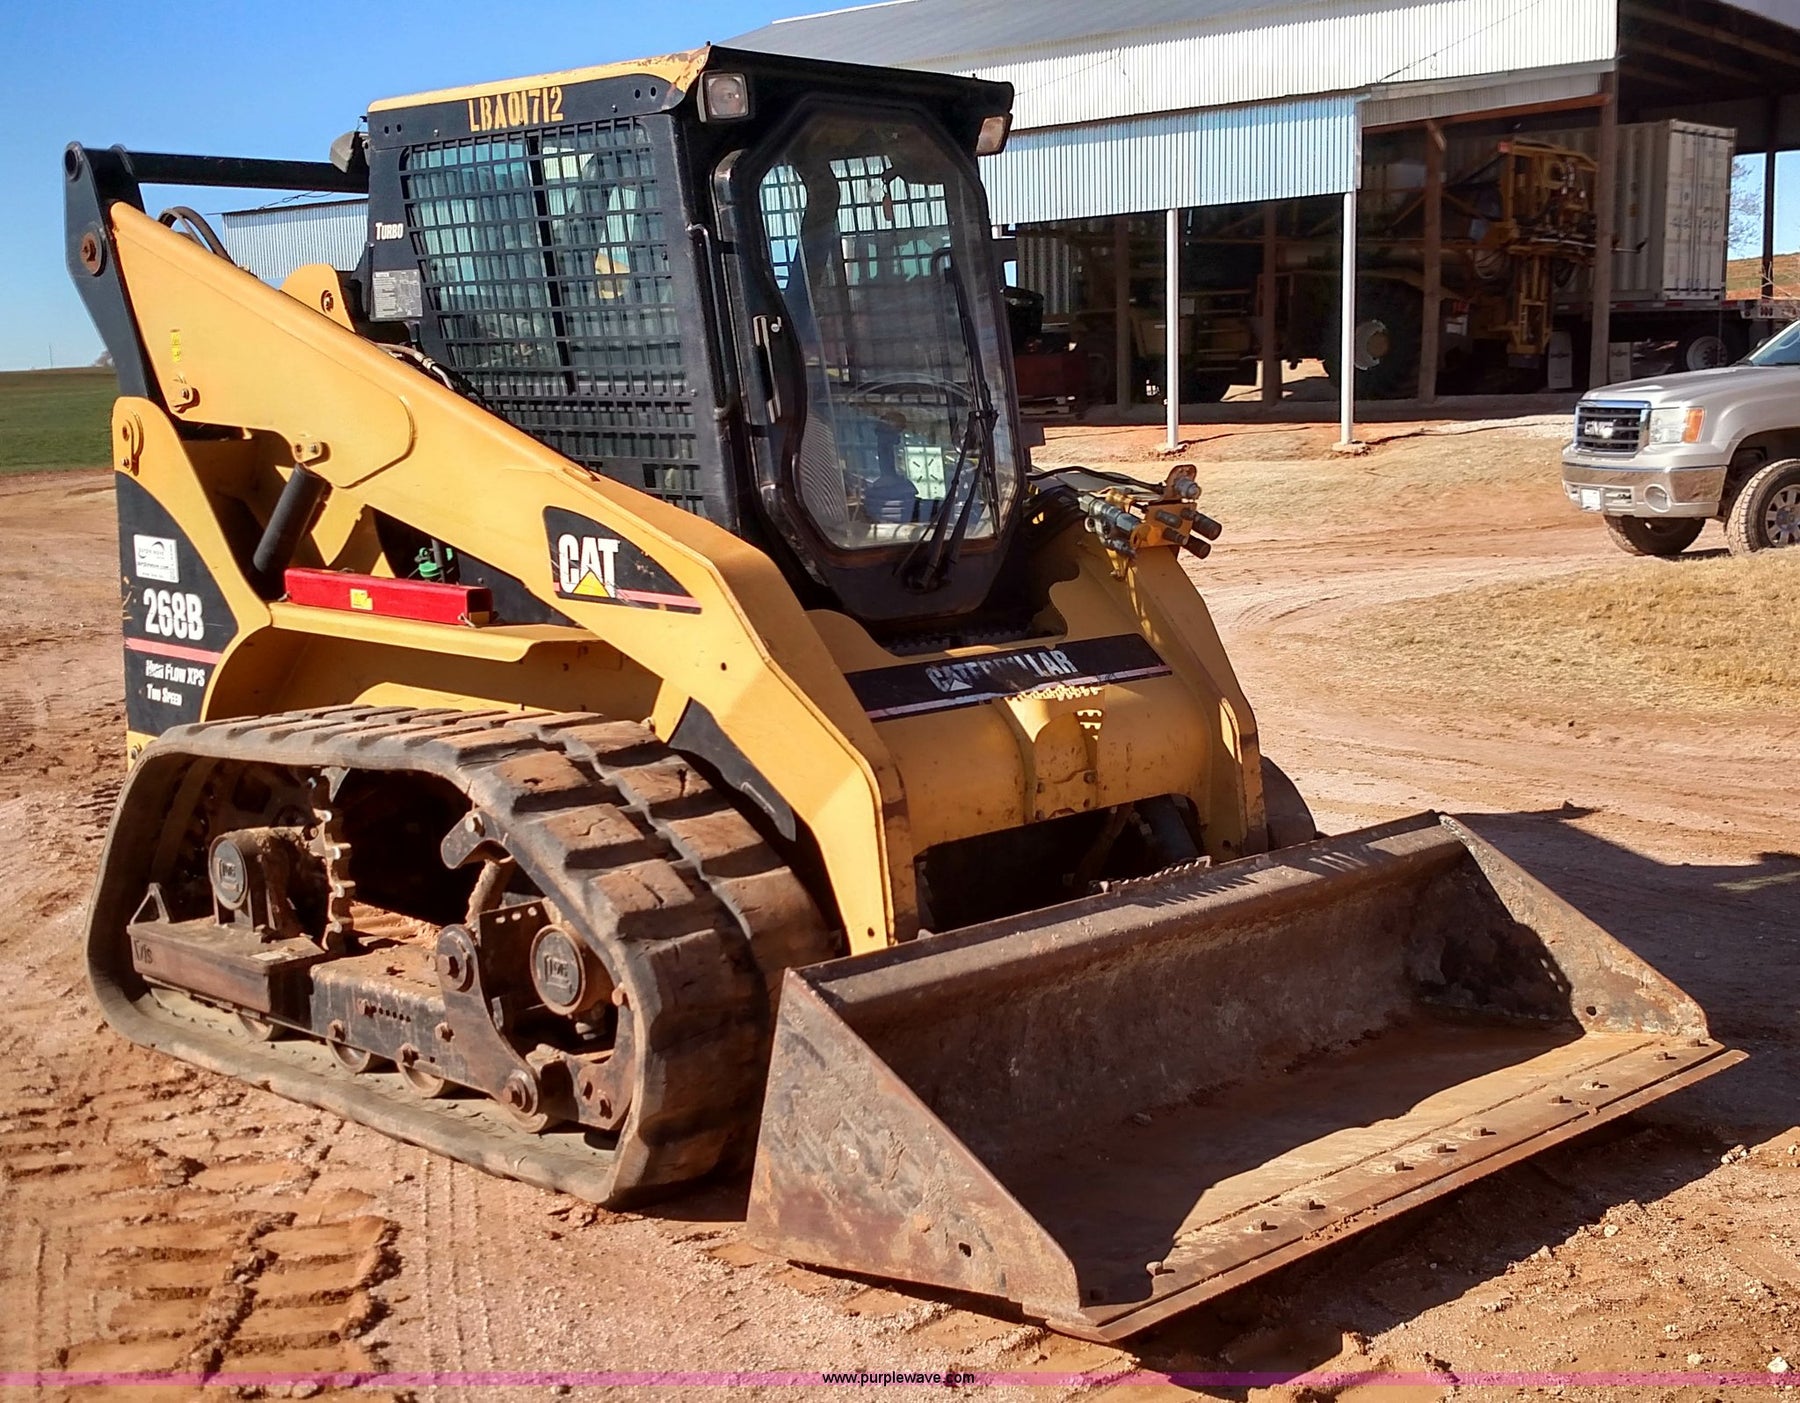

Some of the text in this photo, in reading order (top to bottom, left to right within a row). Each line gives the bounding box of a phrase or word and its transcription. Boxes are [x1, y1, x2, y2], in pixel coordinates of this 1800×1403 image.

[558, 533, 621, 598] CAT
[143, 588, 205, 641] 268B
[186, 666, 206, 688] XPS
[925, 650, 1079, 693] CATERLLAR
